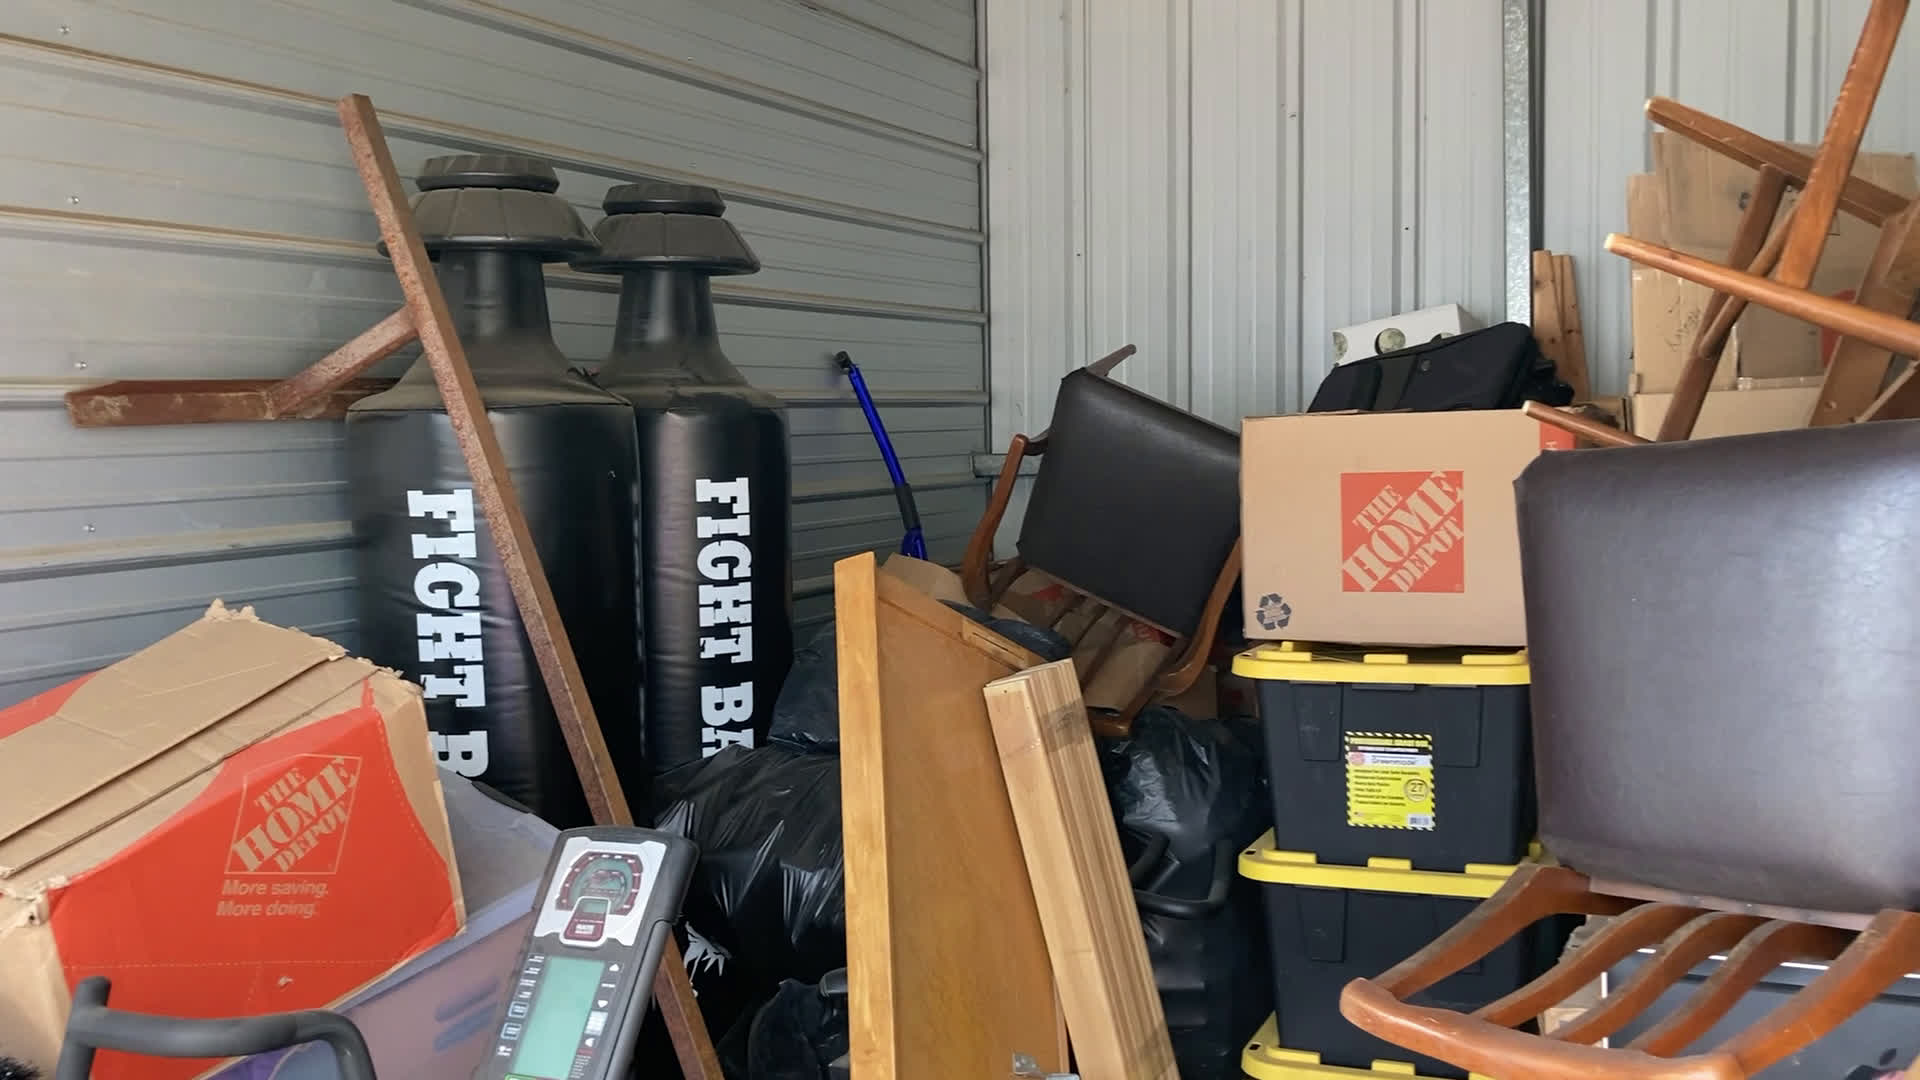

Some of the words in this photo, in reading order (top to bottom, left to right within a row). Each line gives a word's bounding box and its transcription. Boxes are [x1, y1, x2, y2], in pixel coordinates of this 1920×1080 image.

[1342, 469, 1464, 592] HOME
[1352, 484, 1403, 532] THE
[695, 477, 753, 663] FIGHT
[1388, 517, 1464, 592] DEPOT
[407, 489, 486, 708] FIGHT
[232, 757, 357, 872] HOME
[254, 768, 306, 812] THE
[273, 801, 347, 872] DEPOT
[216, 901, 262, 916] More
[222, 880, 266, 895] More
[271, 880, 328, 898] saving.
